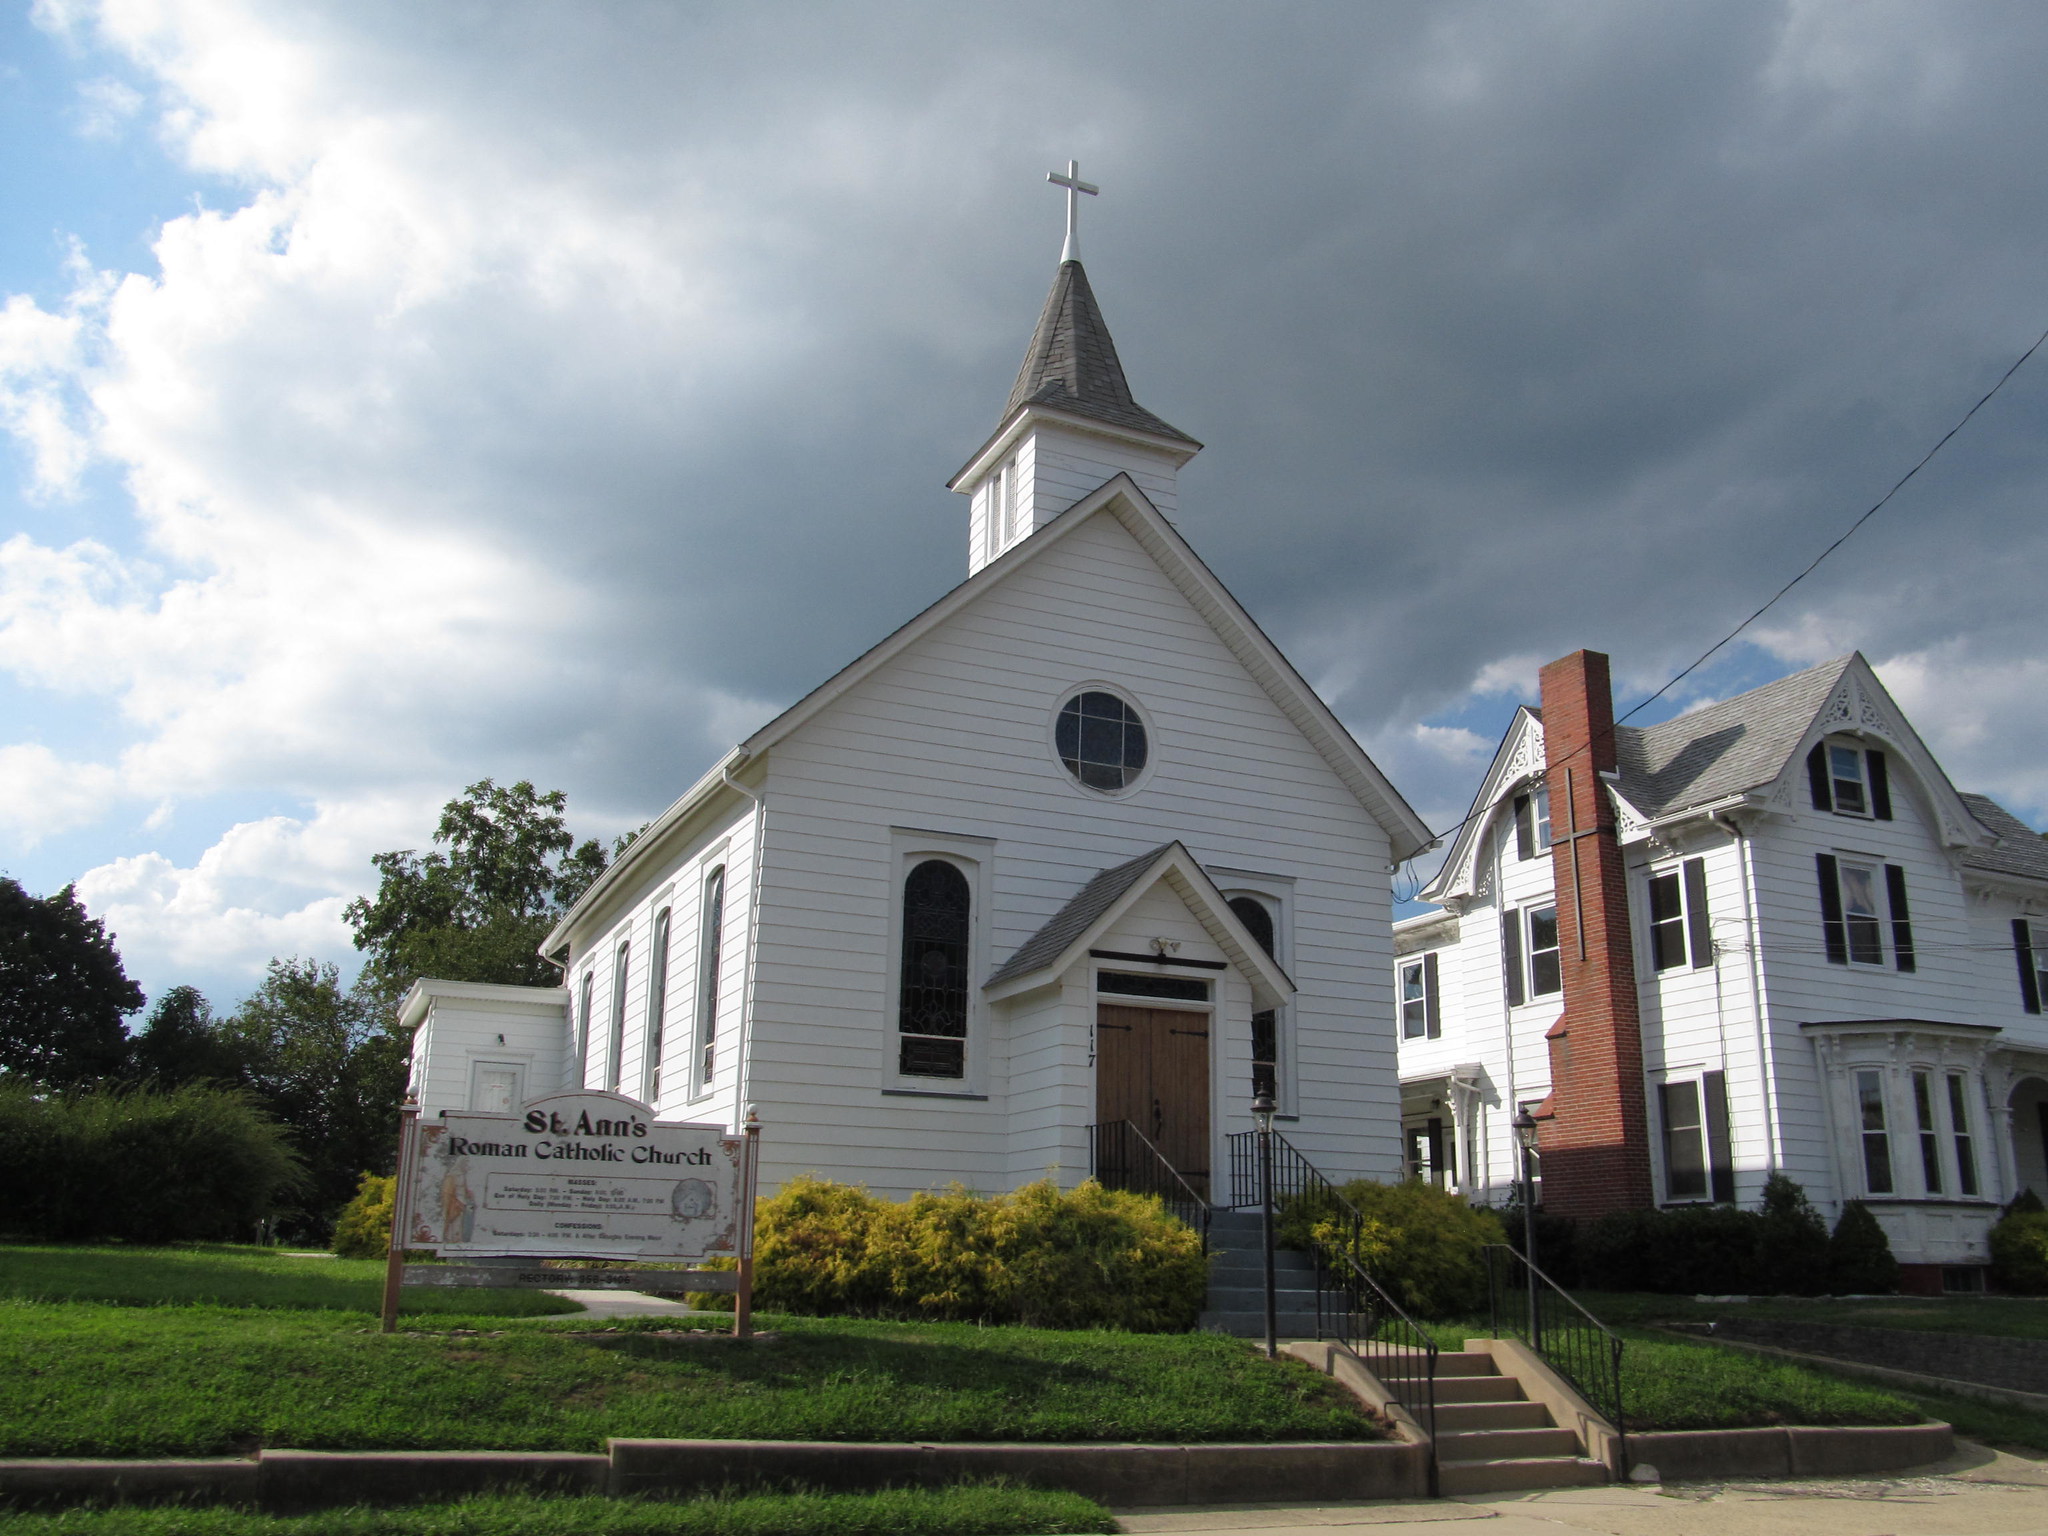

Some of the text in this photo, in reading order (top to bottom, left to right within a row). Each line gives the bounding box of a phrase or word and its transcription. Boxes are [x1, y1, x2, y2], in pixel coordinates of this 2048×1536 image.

[1088, 1024, 1096, 1068] 117
[524, 1109, 648, 1138] St. Ann's
[448, 1137, 713, 1166] Roman Catholic Church
